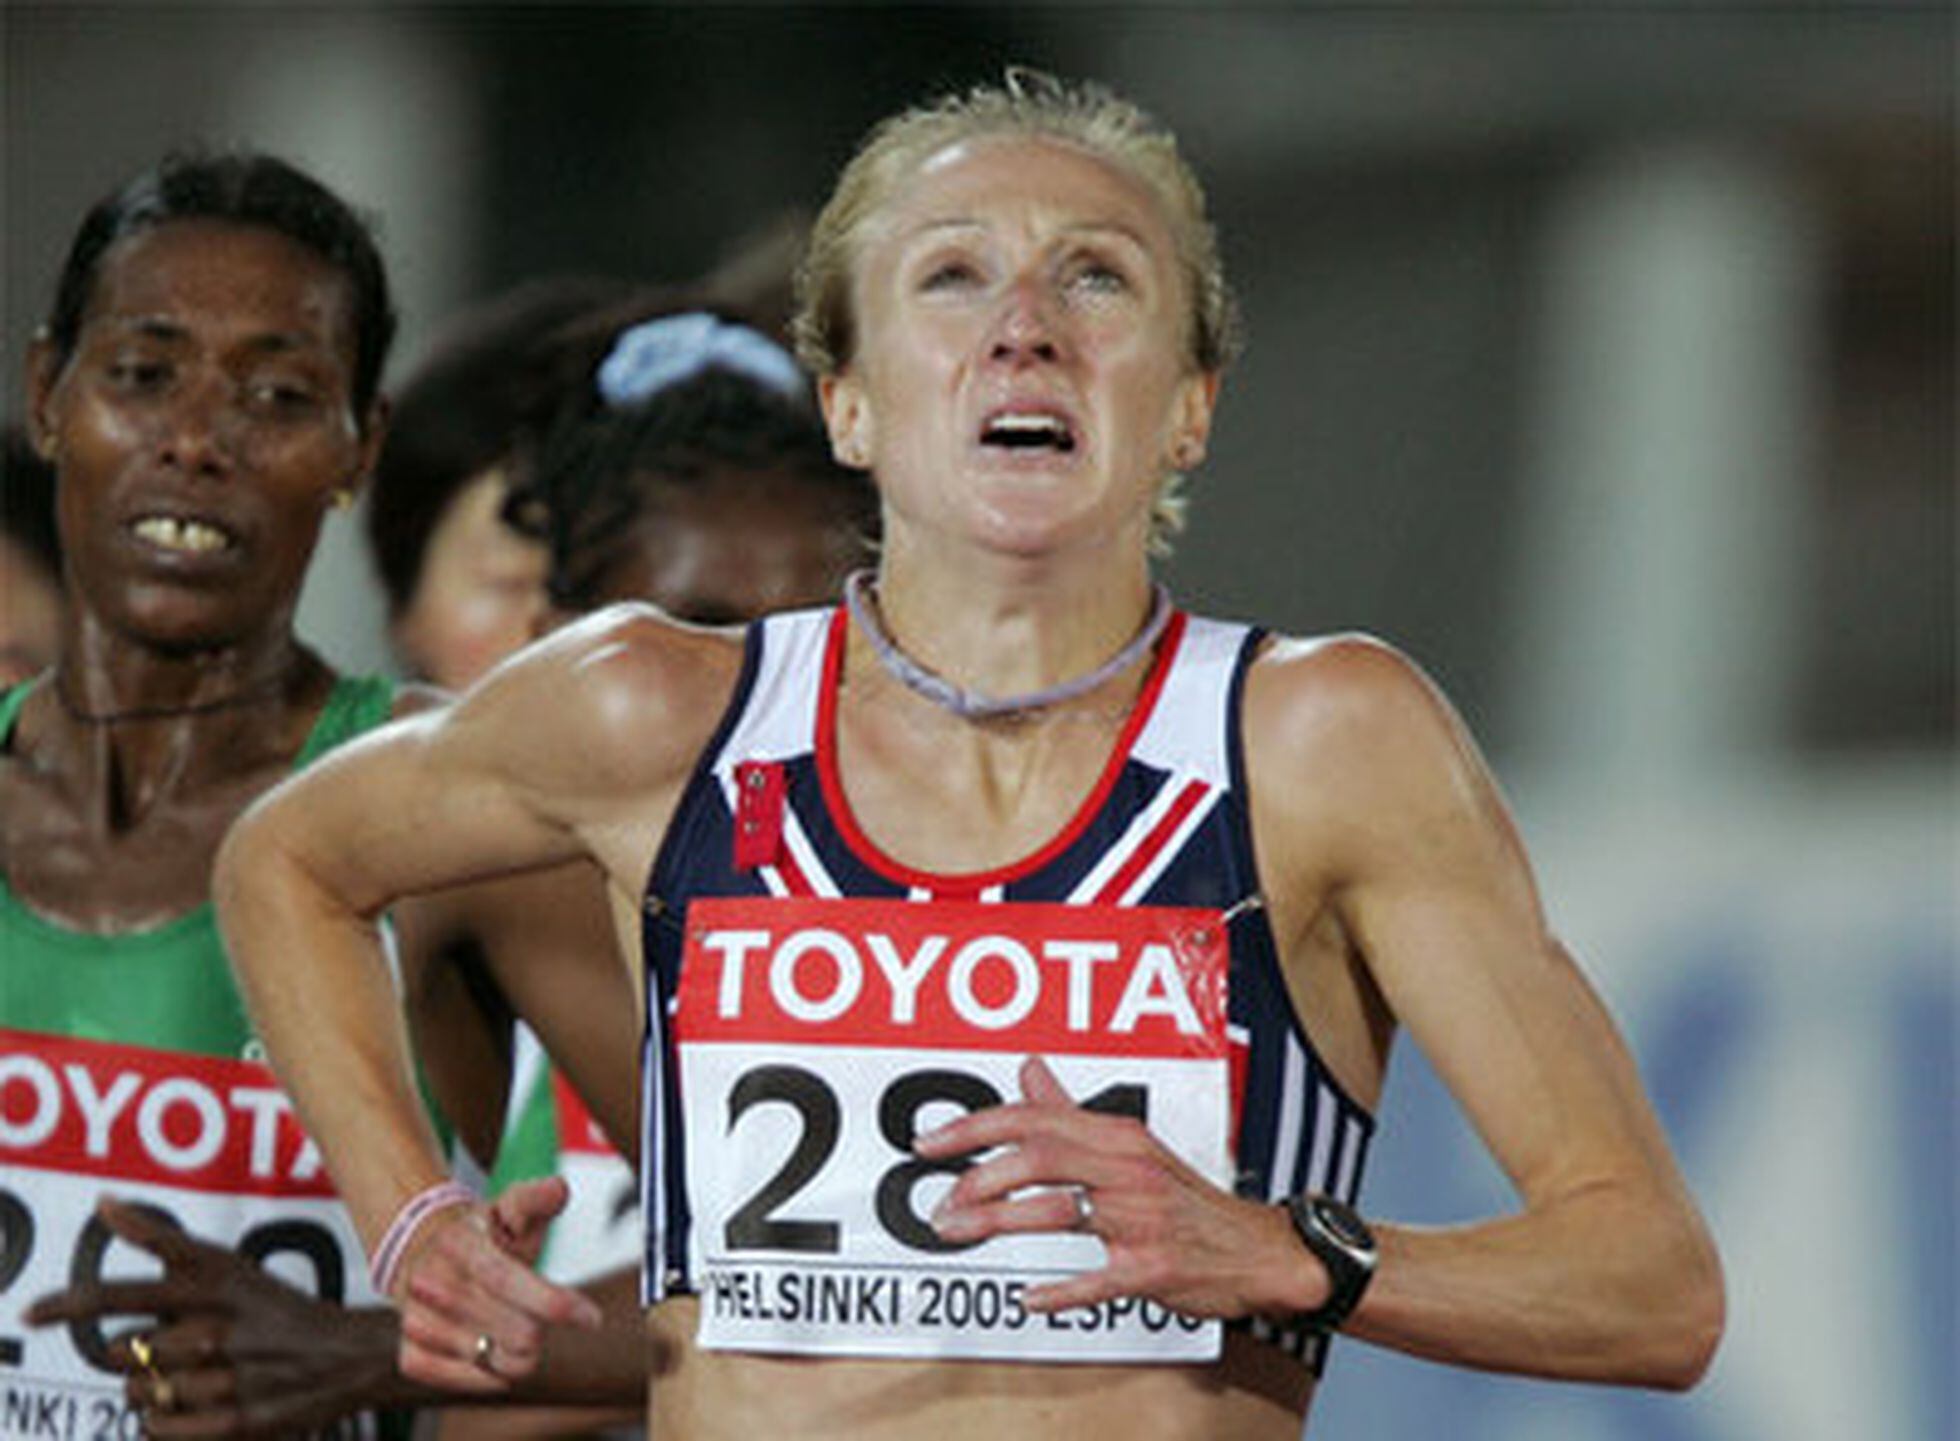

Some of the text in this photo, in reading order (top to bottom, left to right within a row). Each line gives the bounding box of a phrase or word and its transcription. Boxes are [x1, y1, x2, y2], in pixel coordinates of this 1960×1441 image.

[703, 927, 1203, 1034] TOYOTA
[724, 1062, 1149, 1254] 28
[712, 1271, 901, 1325] HELSINKI
[917, 1277, 1027, 1330] 2005
